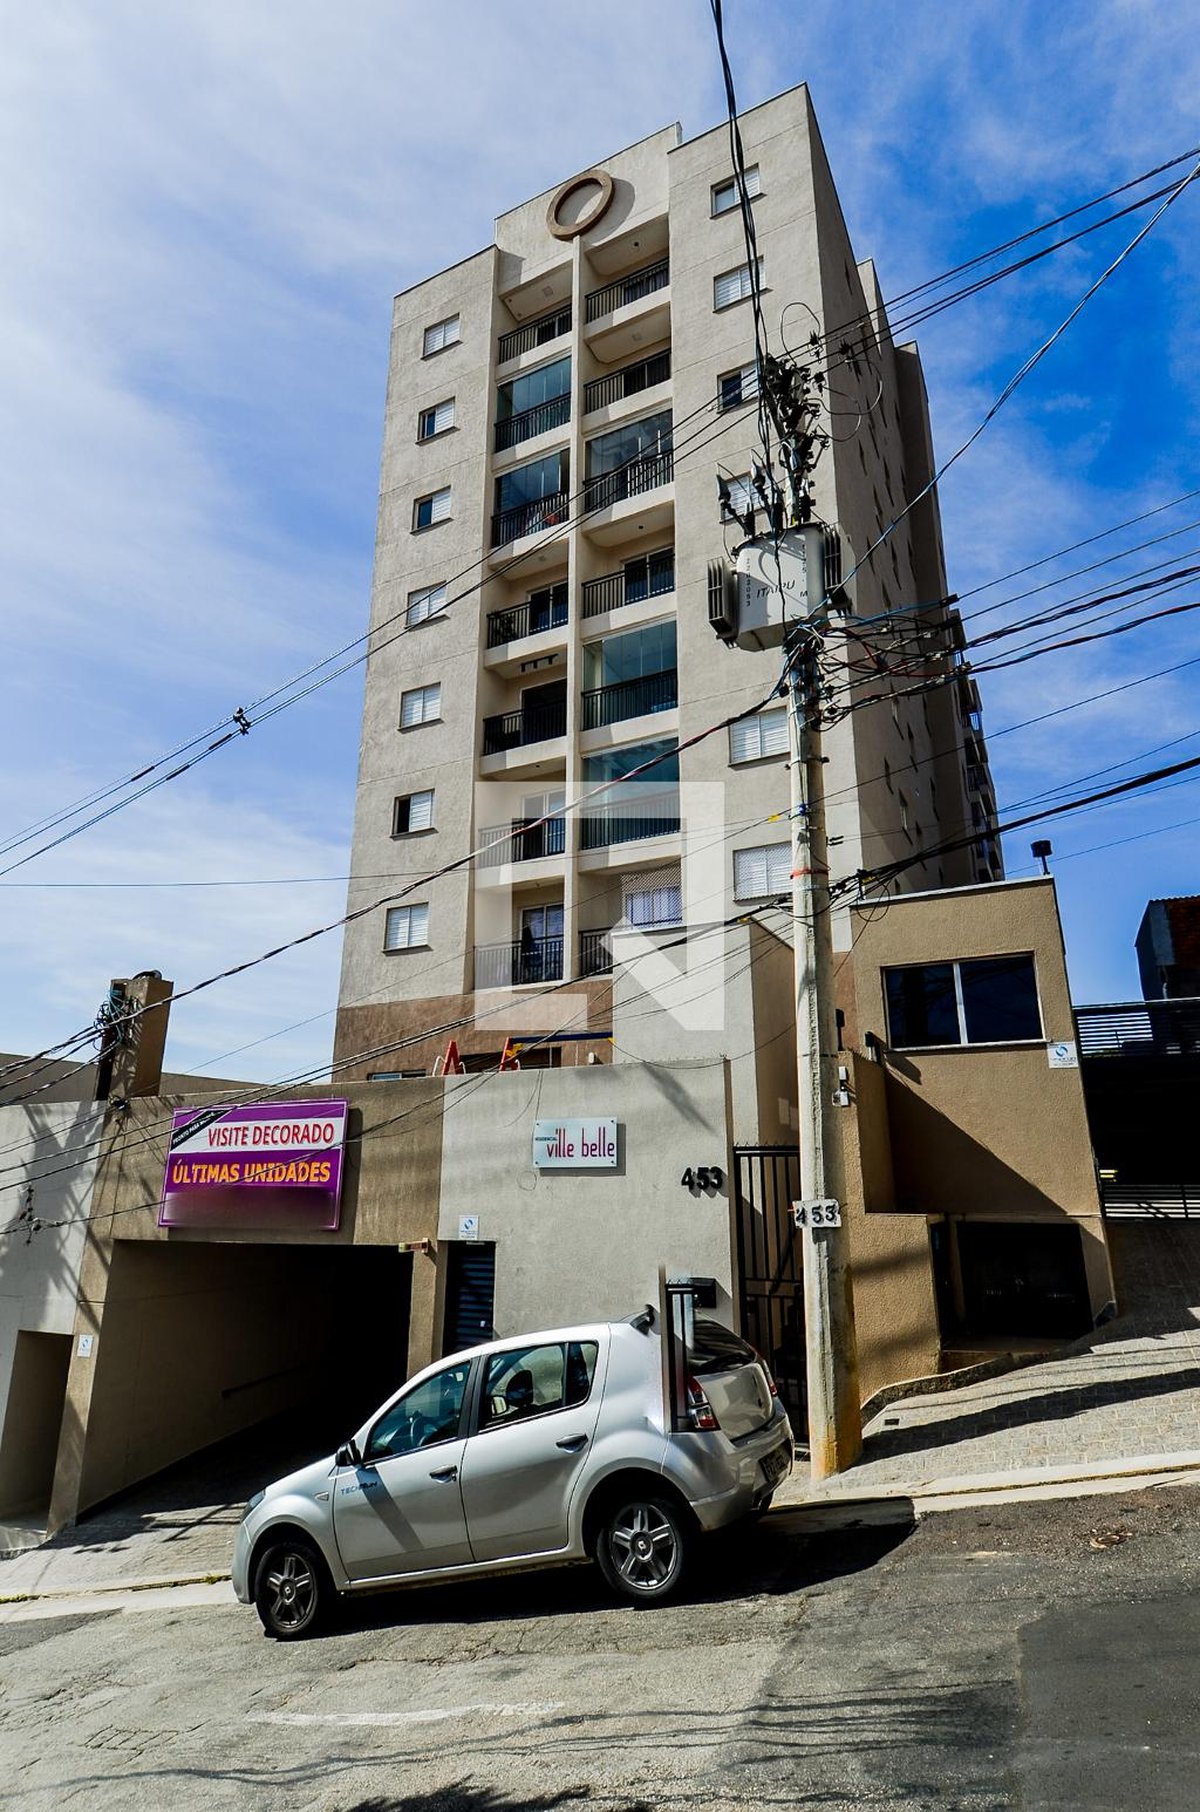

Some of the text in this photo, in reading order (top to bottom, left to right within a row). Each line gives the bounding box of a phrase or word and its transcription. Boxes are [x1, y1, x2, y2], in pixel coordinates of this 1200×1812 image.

[208, 1123, 334, 1147] VISITE DECORADO
[547, 1127, 615, 1158] ville belle
[173, 1159, 331, 1184] ÚLTIMAS UNIDADES
[681, 1166, 723, 1190] 453
[796, 1204, 836, 1224] 453
